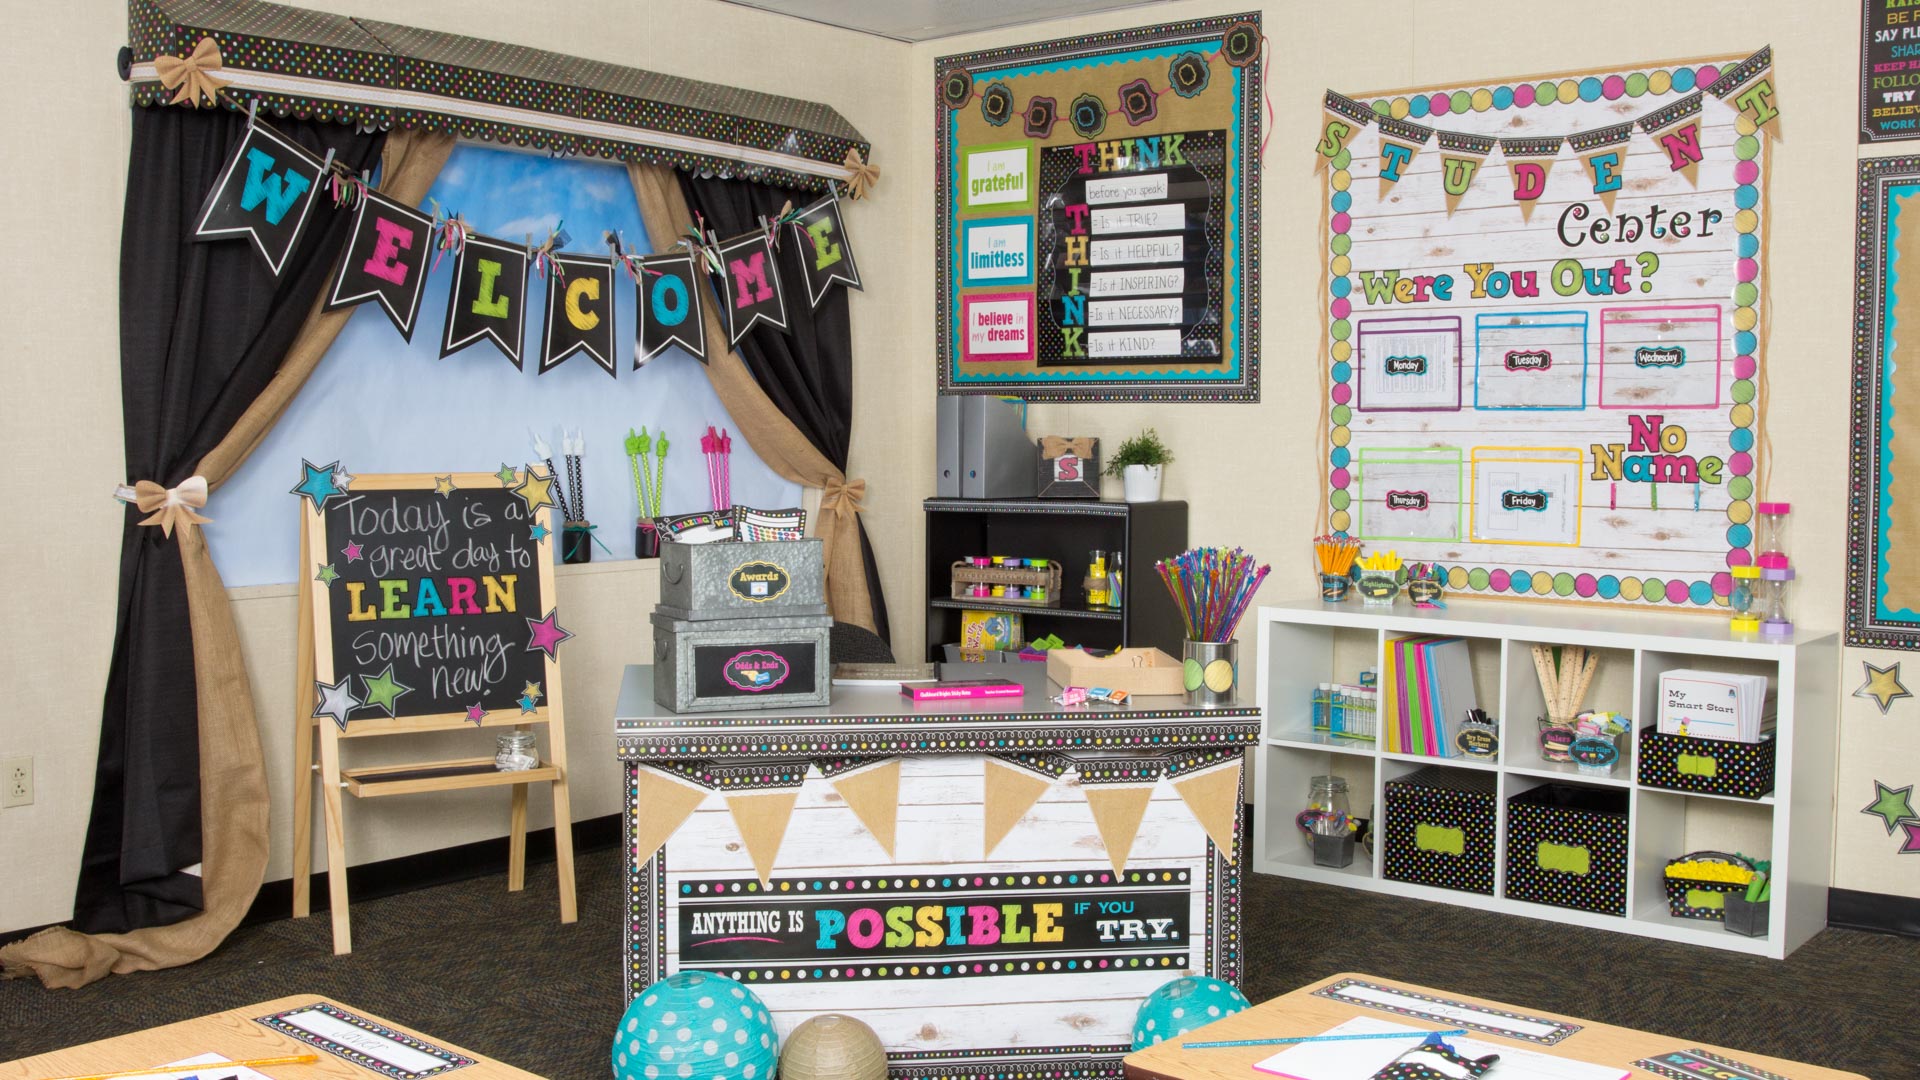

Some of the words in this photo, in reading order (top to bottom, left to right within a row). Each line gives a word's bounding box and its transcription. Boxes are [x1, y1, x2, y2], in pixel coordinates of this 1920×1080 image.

[1887, 12, 1909, 25] BE
[1875, 28, 1899, 43] SAY
[1874, 62, 1906, 73] KEEP
[1883, 90, 1915, 104] TRY
[1880, 119, 1916, 131] WORK
[1316, 79, 1779, 201] STUDENT
[1074, 134, 1187, 174] THINK
[993, 162, 1005, 171] am
[972, 172, 1024, 196] grateful
[1089, 185, 1119, 199] before
[1123, 188, 1137, 200] you
[1140, 182, 1166, 199] speak:
[1557, 202, 1723, 247] Center
[240, 147, 842, 331] WELCOME
[994, 239, 1006, 248] am
[971, 251, 1024, 269] limitless
[1120, 275, 1179, 290] INSPIRING?
[1359, 269, 1454, 305] Were
[1464, 262, 1539, 298] You
[1551, 251, 1659, 297] Out?
[978, 312, 1013, 326] believe
[1016, 311, 1024, 324] in
[1119, 305, 1179, 321] NECESSARY?
[972, 332, 985, 342] my
[988, 327, 1024, 342] dreams
[1120, 338, 1155, 351] KIND?
[1512, 355, 1542, 367] Tuesday
[1638, 351, 1678, 364] Wednesday
[1393, 361, 1419, 372] Monday
[1628, 415, 1687, 453] No
[1058, 457, 1079, 481] S
[1591, 443, 1723, 484] Name
[1392, 495, 1421, 507] Thursday
[1511, 495, 1536, 507] Friday
[332, 495, 450, 550] Today
[462, 497, 491, 530] is
[504, 502, 523, 521] a
[671, 515, 710, 533] AMAZING
[369, 535, 441, 578] great
[452, 538, 500, 573] day
[504, 534, 531, 569] to
[740, 571, 779, 582] Awards
[346, 574, 518, 622] LEARN
[735, 661, 752, 670] Odds
[754, 661, 760, 669] &
[762, 661, 778, 669] Ends
[1669, 690, 1686, 700] My
[1668, 700, 1703, 710] Smart
[1706, 703, 1734, 714] Start
[1546, 734, 1571, 743] Rulers
[1575, 744, 1594, 752] Binder
[1596, 745, 1612, 754] Clips
[1074, 902, 1091, 915] IF
[1097, 901, 1134, 914] YOU
[691, 911, 781, 935] ANYTHING
[788, 910, 804, 932] IS
[815, 903, 1064, 949] POSSIBLE
[1096, 918, 1179, 942] TRY.
